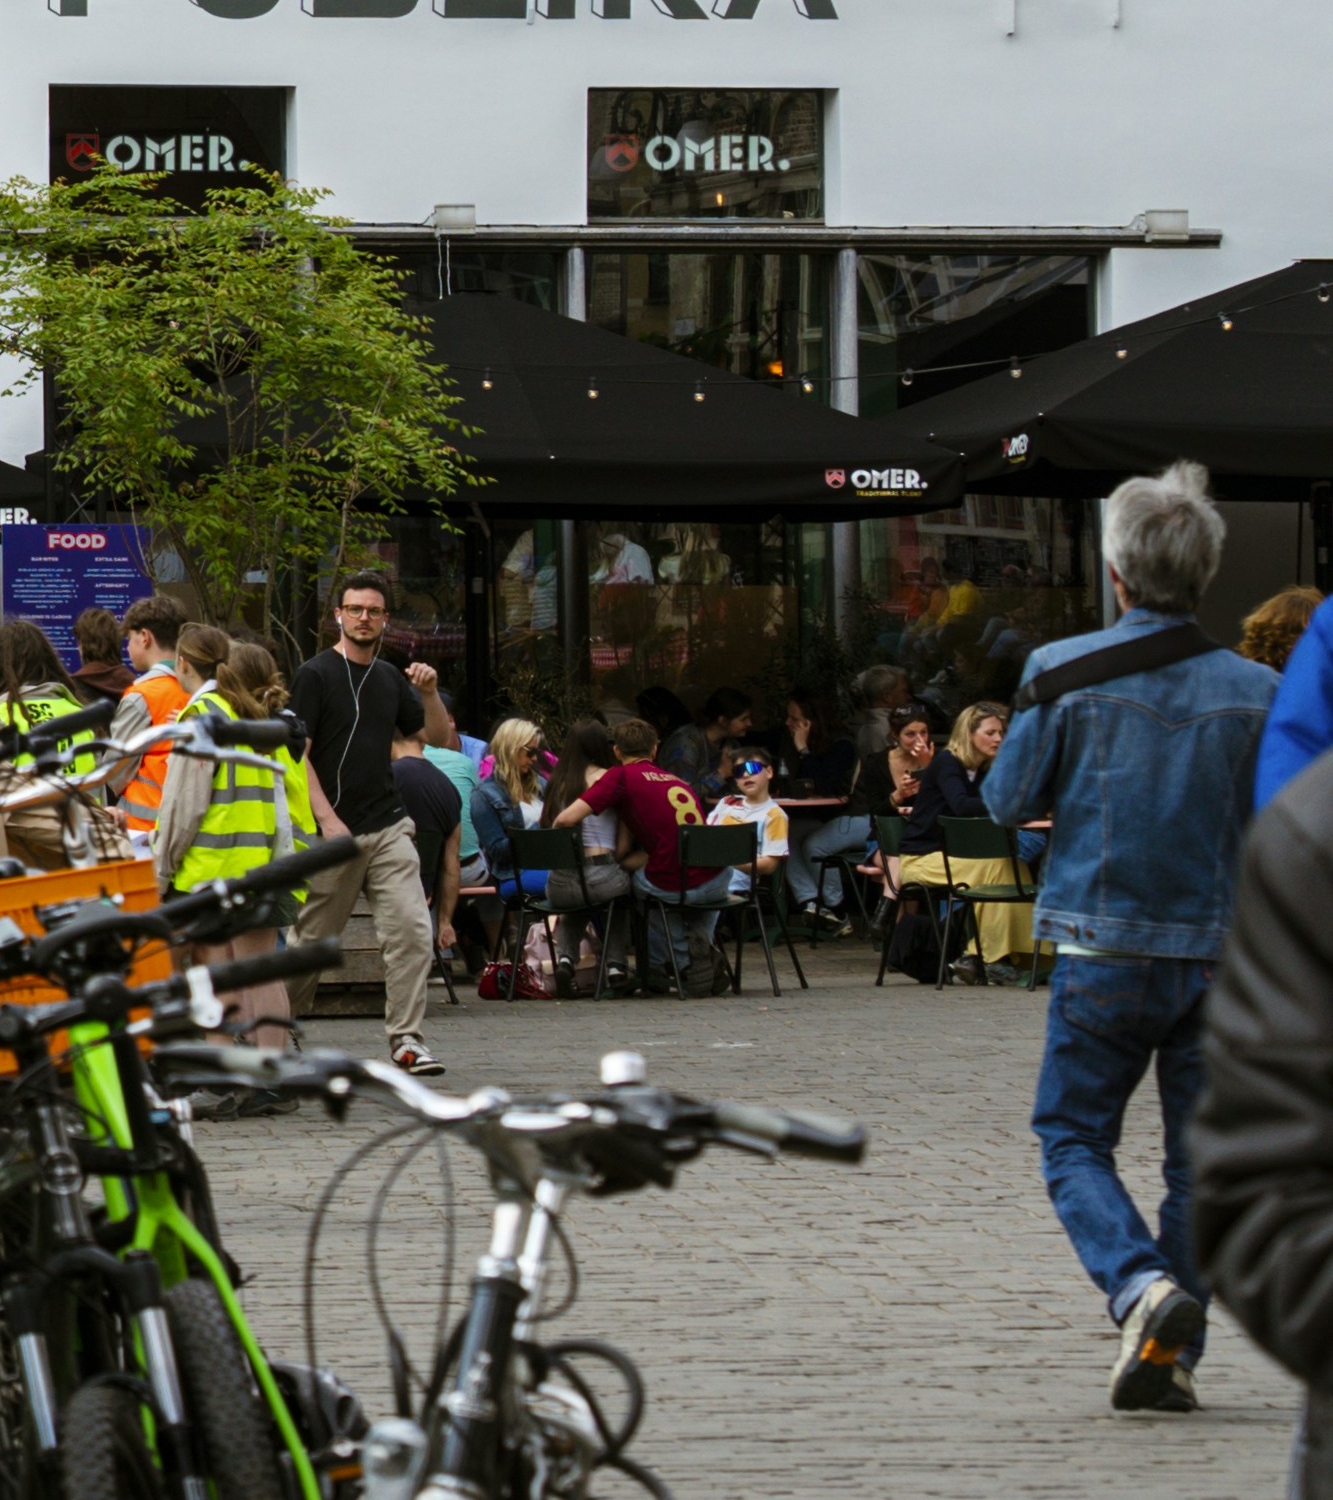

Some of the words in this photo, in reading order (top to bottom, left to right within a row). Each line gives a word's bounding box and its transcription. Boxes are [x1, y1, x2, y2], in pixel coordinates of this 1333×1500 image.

[645, 134, 791, 172] OMER.
[47, 532, 107, 550] FOOD
[667, 785, 704, 825] 8
